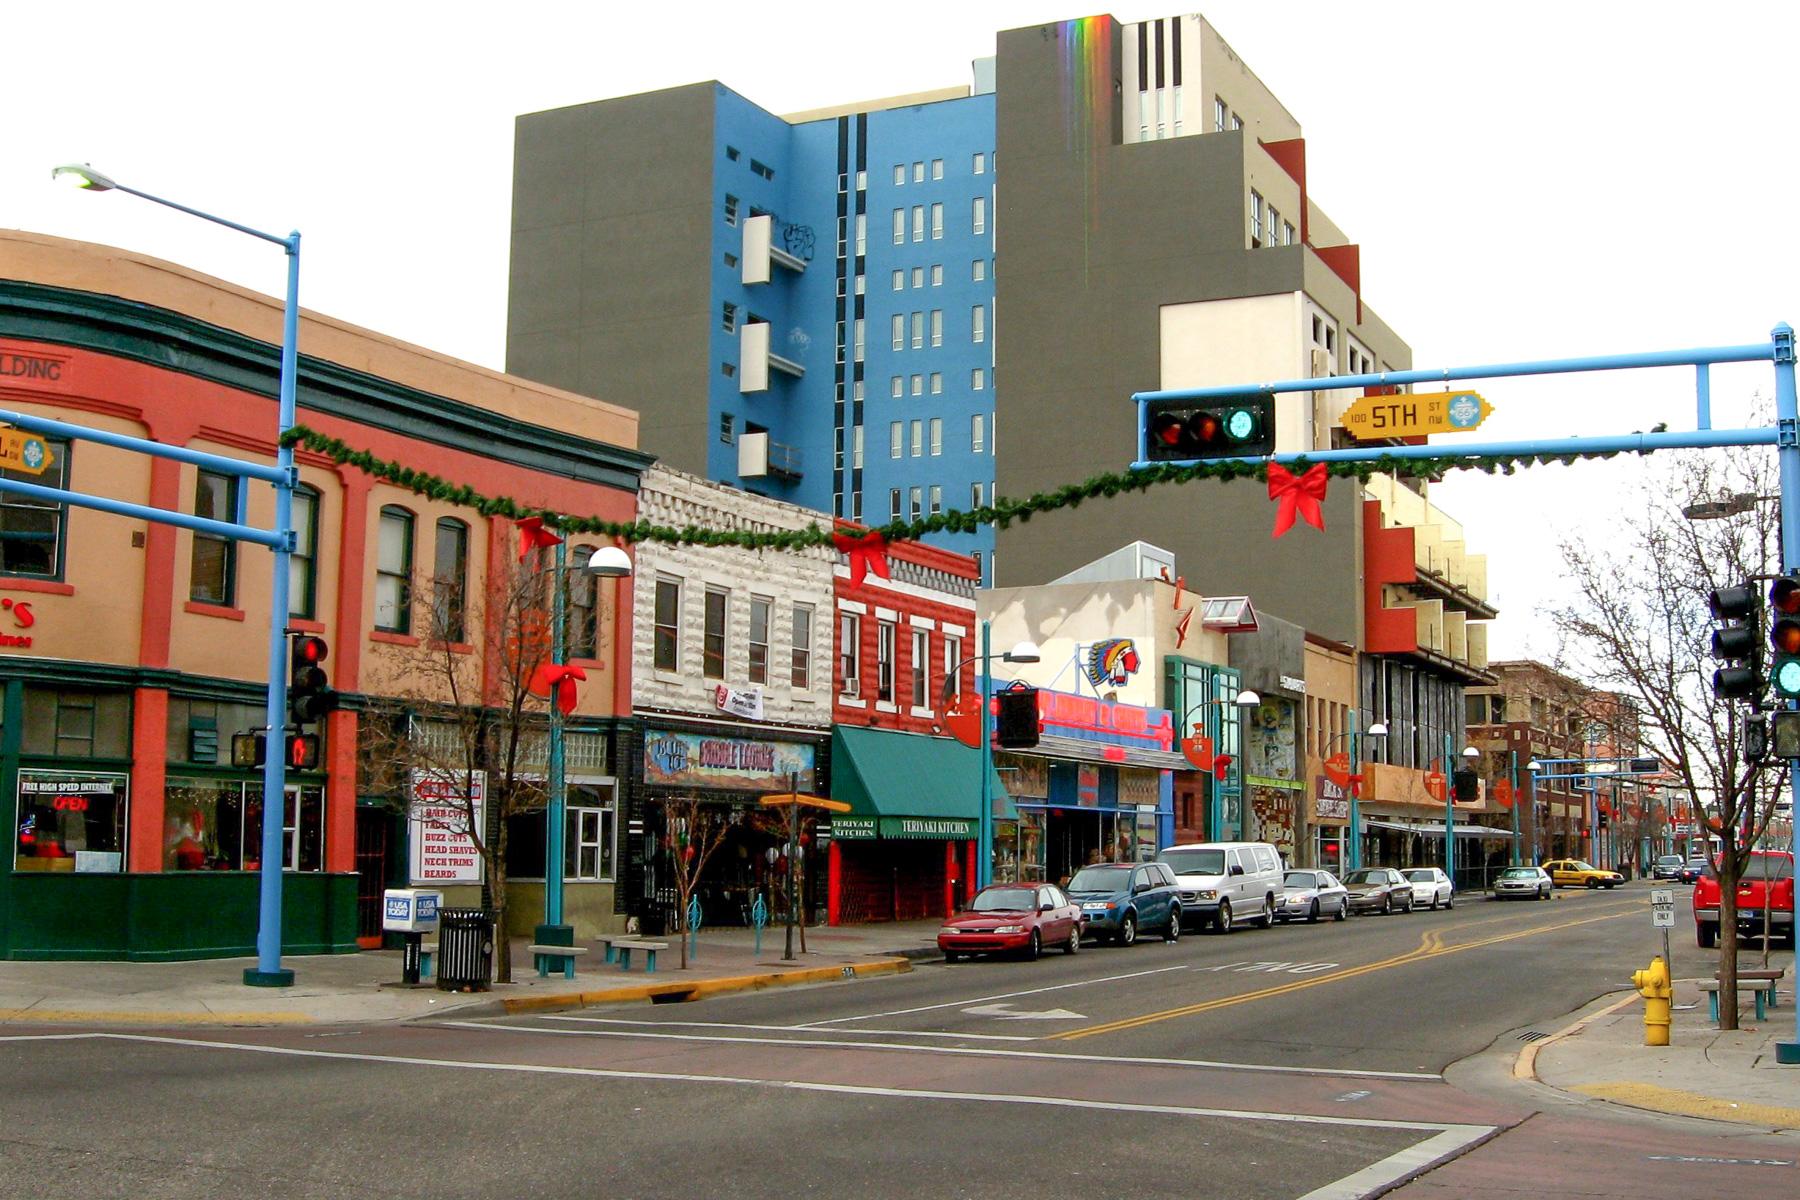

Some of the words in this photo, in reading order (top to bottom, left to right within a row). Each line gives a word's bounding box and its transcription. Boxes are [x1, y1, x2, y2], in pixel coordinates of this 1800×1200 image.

[1351, 413, 1367, 423] 100
[1372, 403, 1417, 428] 5TH
[1428, 401, 1441, 412] ST
[22, 782, 38, 791] FREE
[39, 782, 57, 791] HIGH
[58, 782, 80, 792] SPEED
[80, 783, 113, 792] INTERNET
[53, 796, 88, 811] OPEN
[832, 820, 874, 828] TERIYAKI
[902, 820, 936, 833] TERIYAKI
[938, 821, 969, 833] KITCHEN
[425, 833, 446, 842] BUZZ
[448, 834, 468, 842] CUTS
[834, 829, 874, 838] KITCHEN
[424, 846, 447, 854] HEAD
[449, 846, 478, 855] SHAVES
[424, 858, 447, 866] NECK
[448, 858, 474, 866] TRIMS
[424, 870, 457, 878] BEARDS
[394, 901, 408, 909] USA
[422, 900, 435, 909] USA
[387, 908, 409, 916] TODAY
